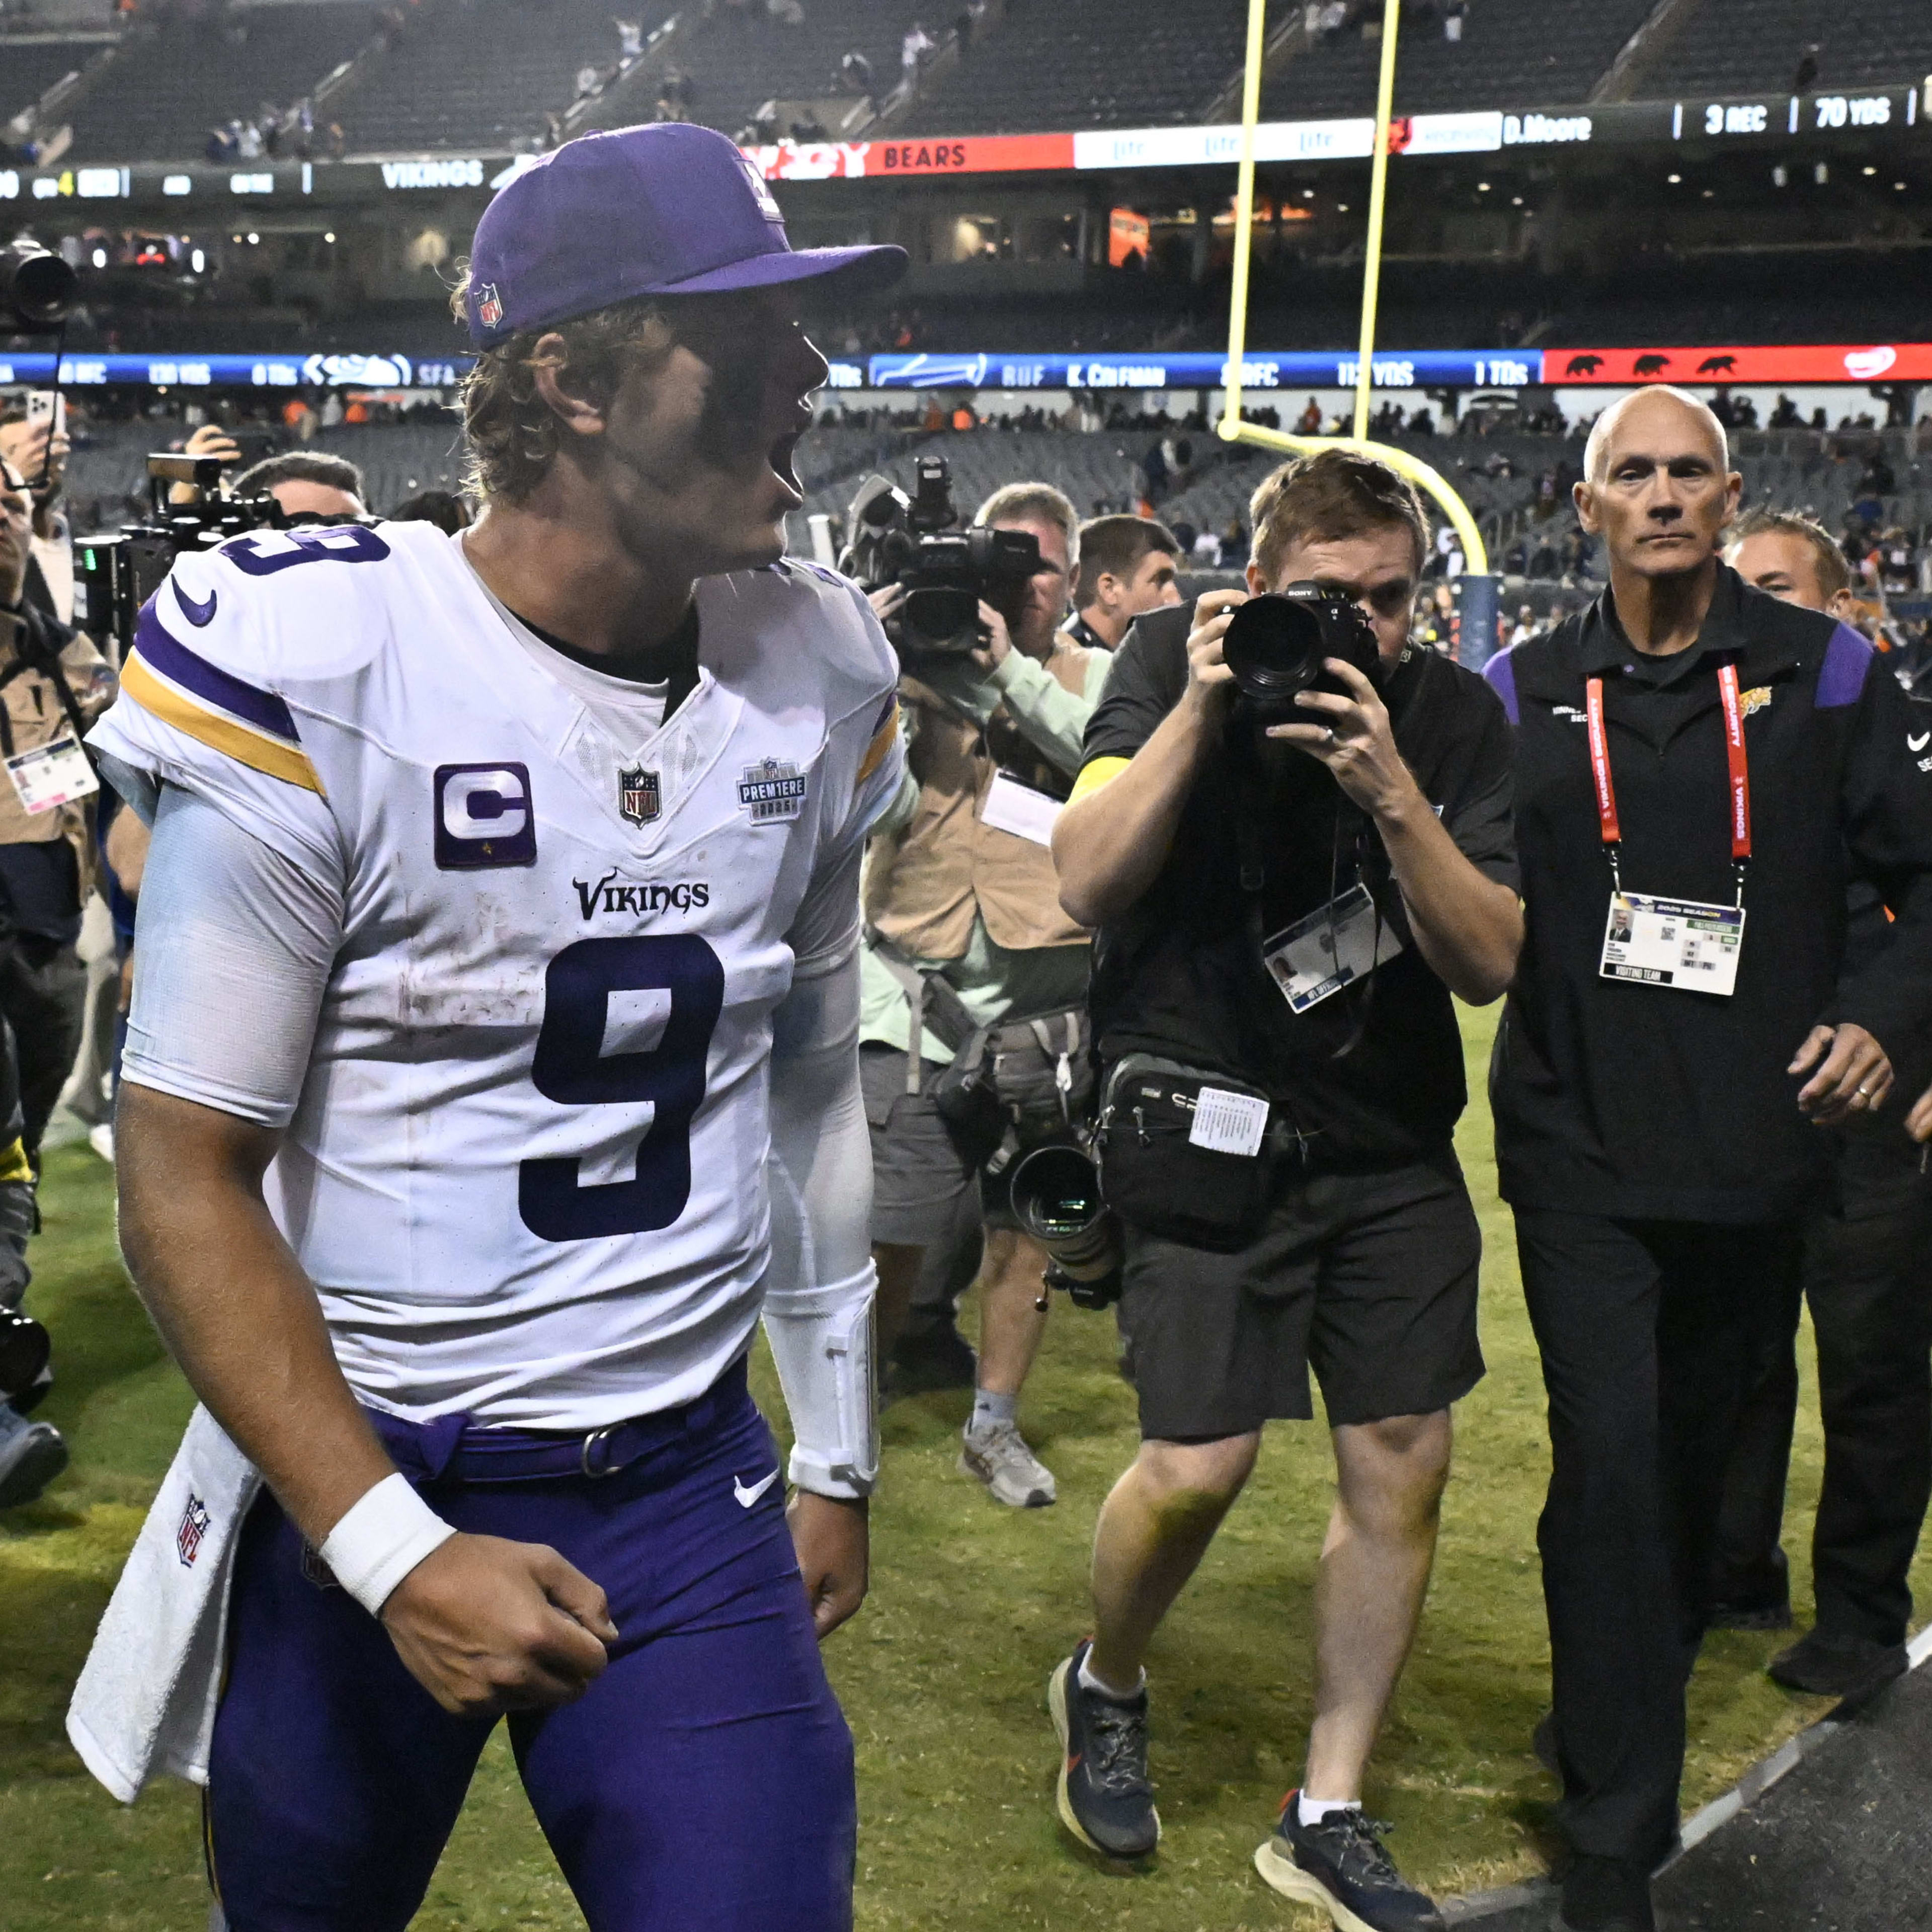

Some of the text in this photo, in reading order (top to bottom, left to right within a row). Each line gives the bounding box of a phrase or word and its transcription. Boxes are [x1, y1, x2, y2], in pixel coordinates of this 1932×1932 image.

[1706, 104, 1767, 134] 3 REC
[1815, 96, 1891, 128] 70 YDS
[884, 144, 965, 170] BEARS
[381, 162, 484, 189] VIKINGS
[1373, 361, 1414, 386] YDS
[1725, 684, 1741, 747] SECURITY
[1595, 758, 1611, 809] VIKINGS
[443, 770, 527, 839] C
[624, 791, 657, 816] NFL
[1735, 786, 1746, 839] VIKINGS
[1643, 969, 1661, 982] TEAM
[518, 933, 725, 1242] 9
